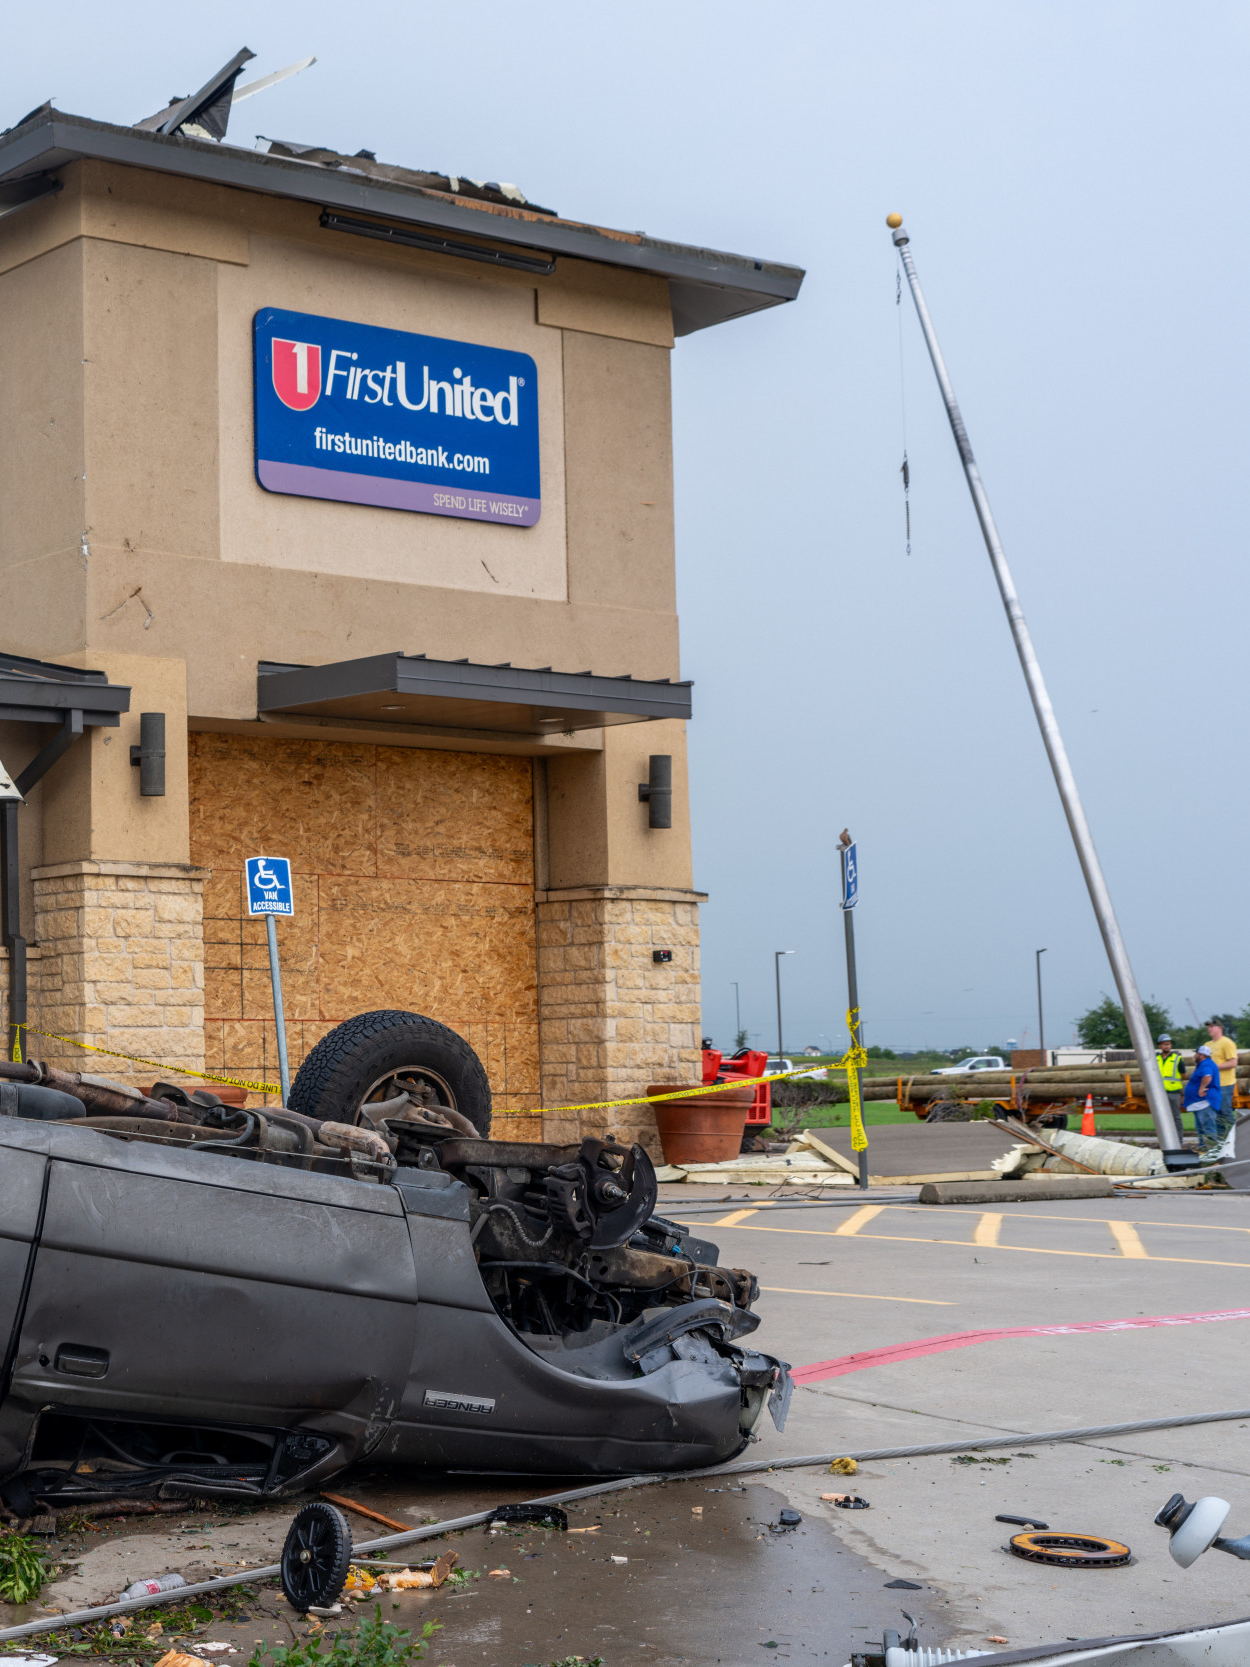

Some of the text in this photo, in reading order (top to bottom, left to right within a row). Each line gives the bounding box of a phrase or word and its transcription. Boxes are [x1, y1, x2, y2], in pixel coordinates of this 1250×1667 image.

[314, 427, 490, 475] firstunitedbank.com
[433, 493, 466, 509] SPEND
[468, 497, 488, 513] LIFE
[263, 890, 278, 900] VAN
[253, 901, 290, 912] ACCESSIBLE
[229, 1078, 245, 1086] NOT
[247, 1081, 259, 1090] DO
[260, 1083, 278, 1093] LINE
[424, 1398, 493, 1414] RANGER
